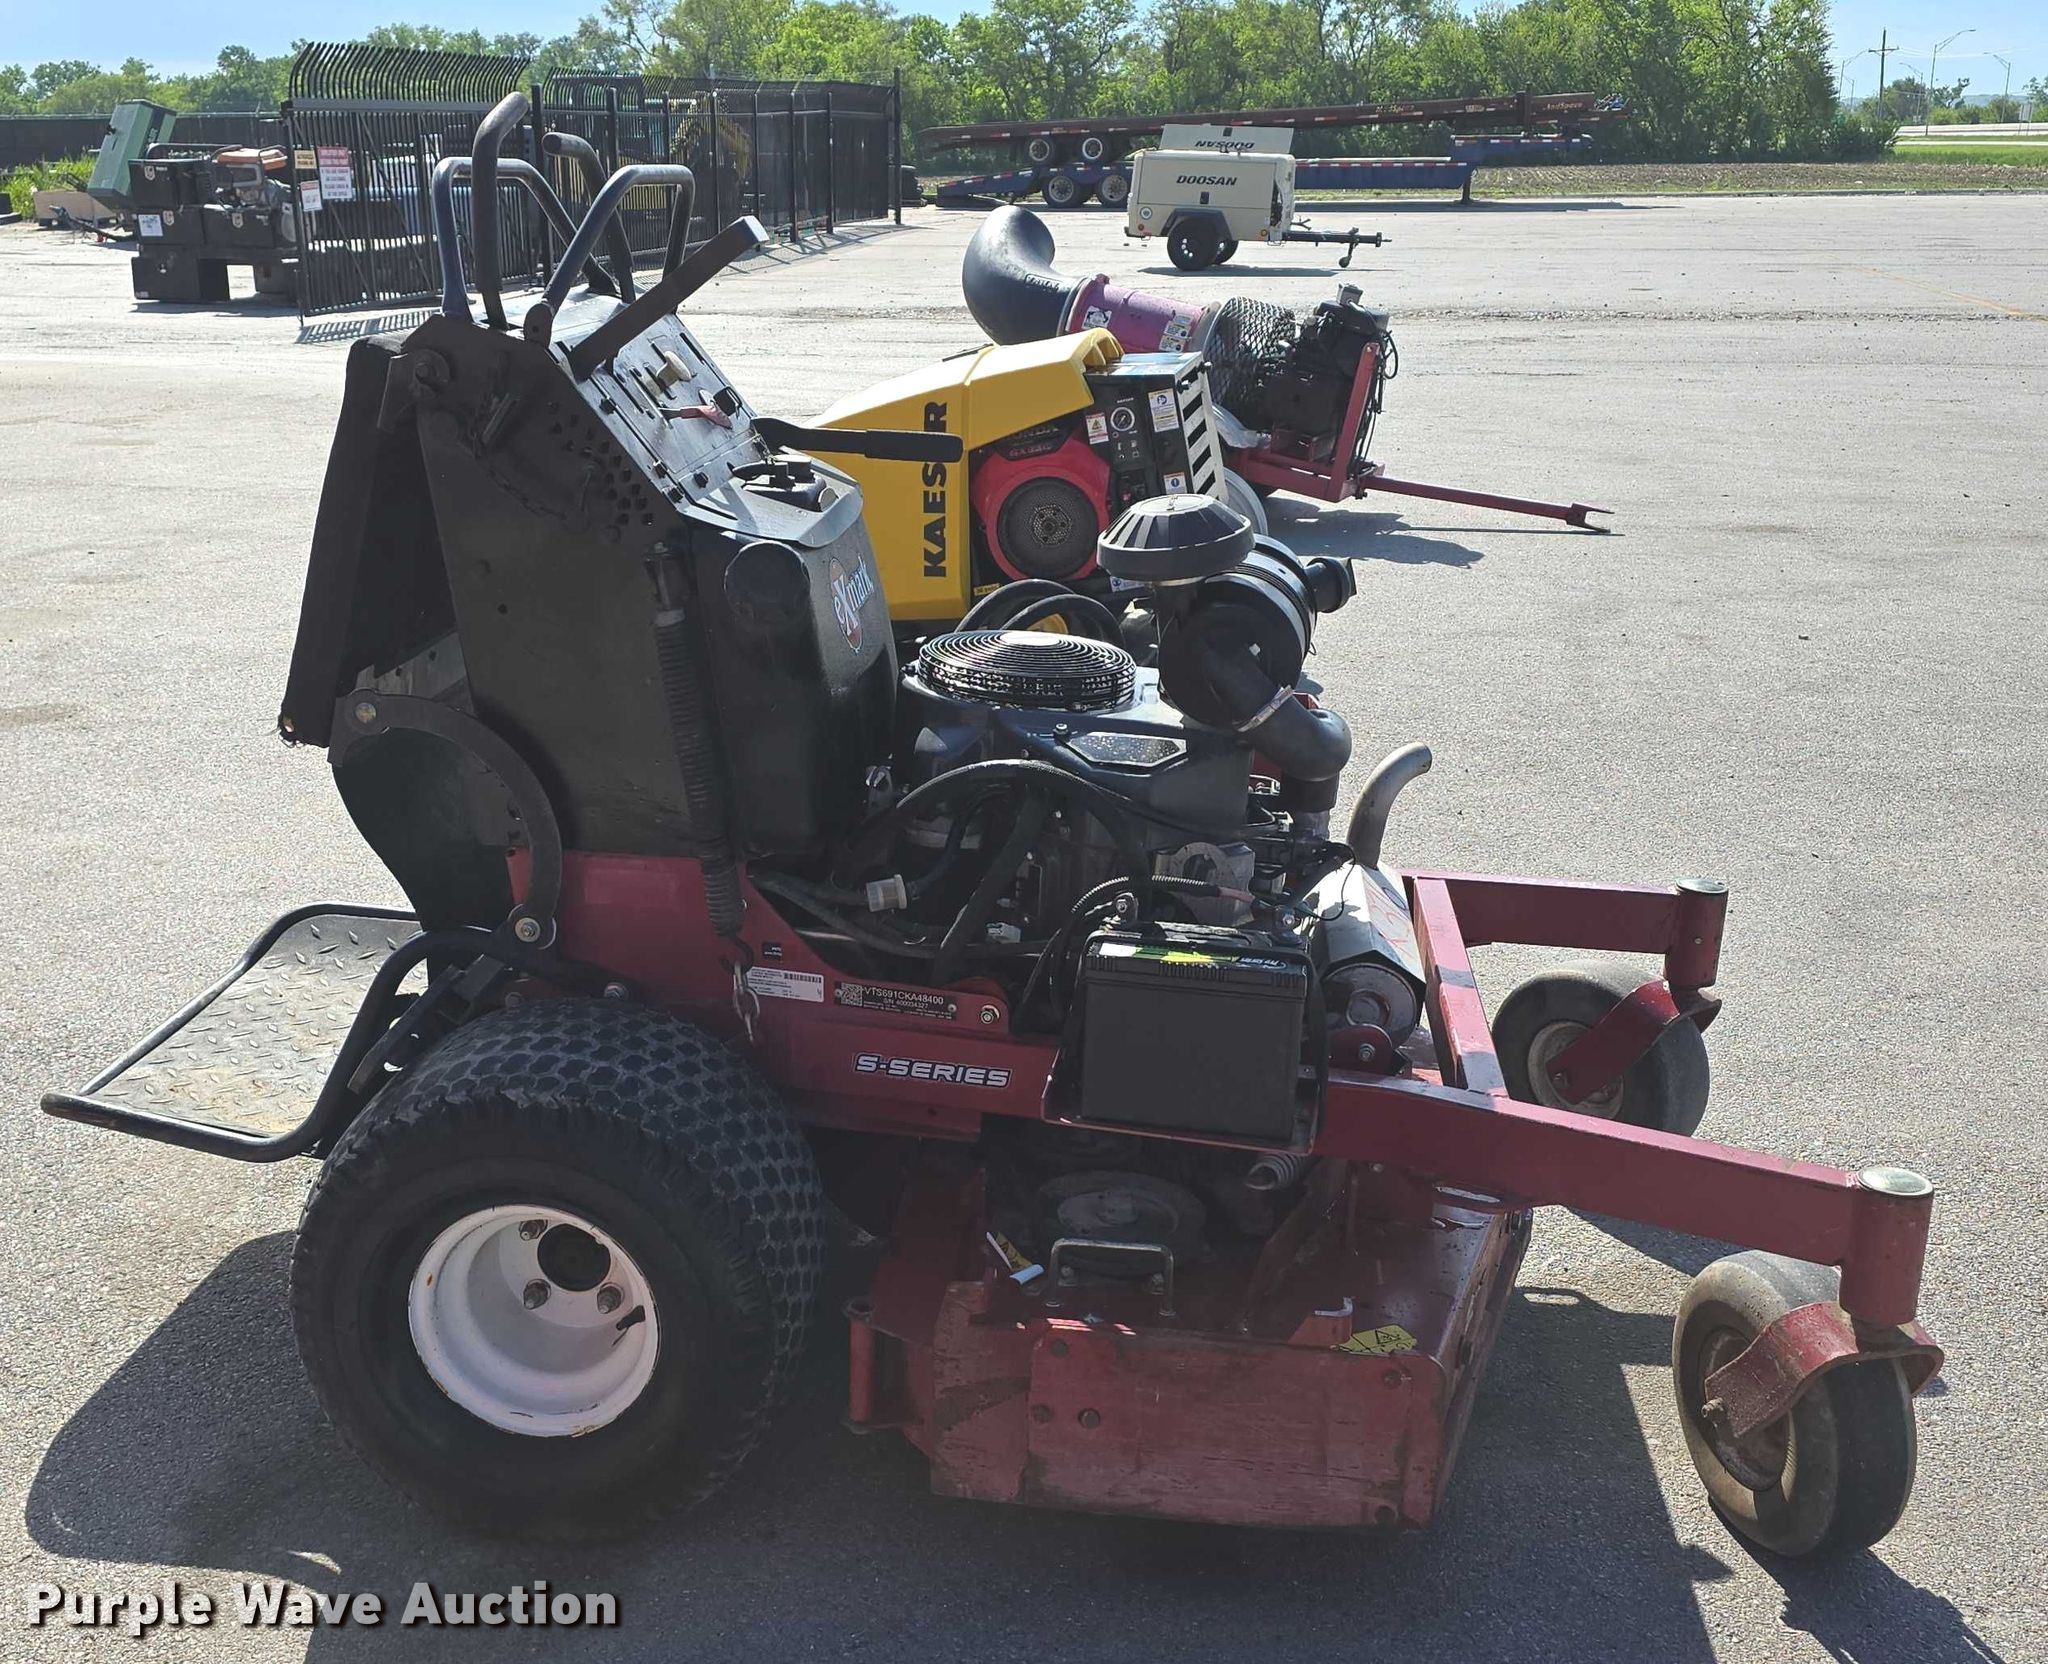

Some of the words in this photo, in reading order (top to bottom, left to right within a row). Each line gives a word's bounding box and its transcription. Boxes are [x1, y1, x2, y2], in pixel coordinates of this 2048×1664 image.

[1194, 140, 1255, 150] DOOSAN
[1176, 175, 1238, 186] DOOSAN
[922, 401, 948, 578] KAESR
[854, 1053, 1011, 1089] S-SERIES
